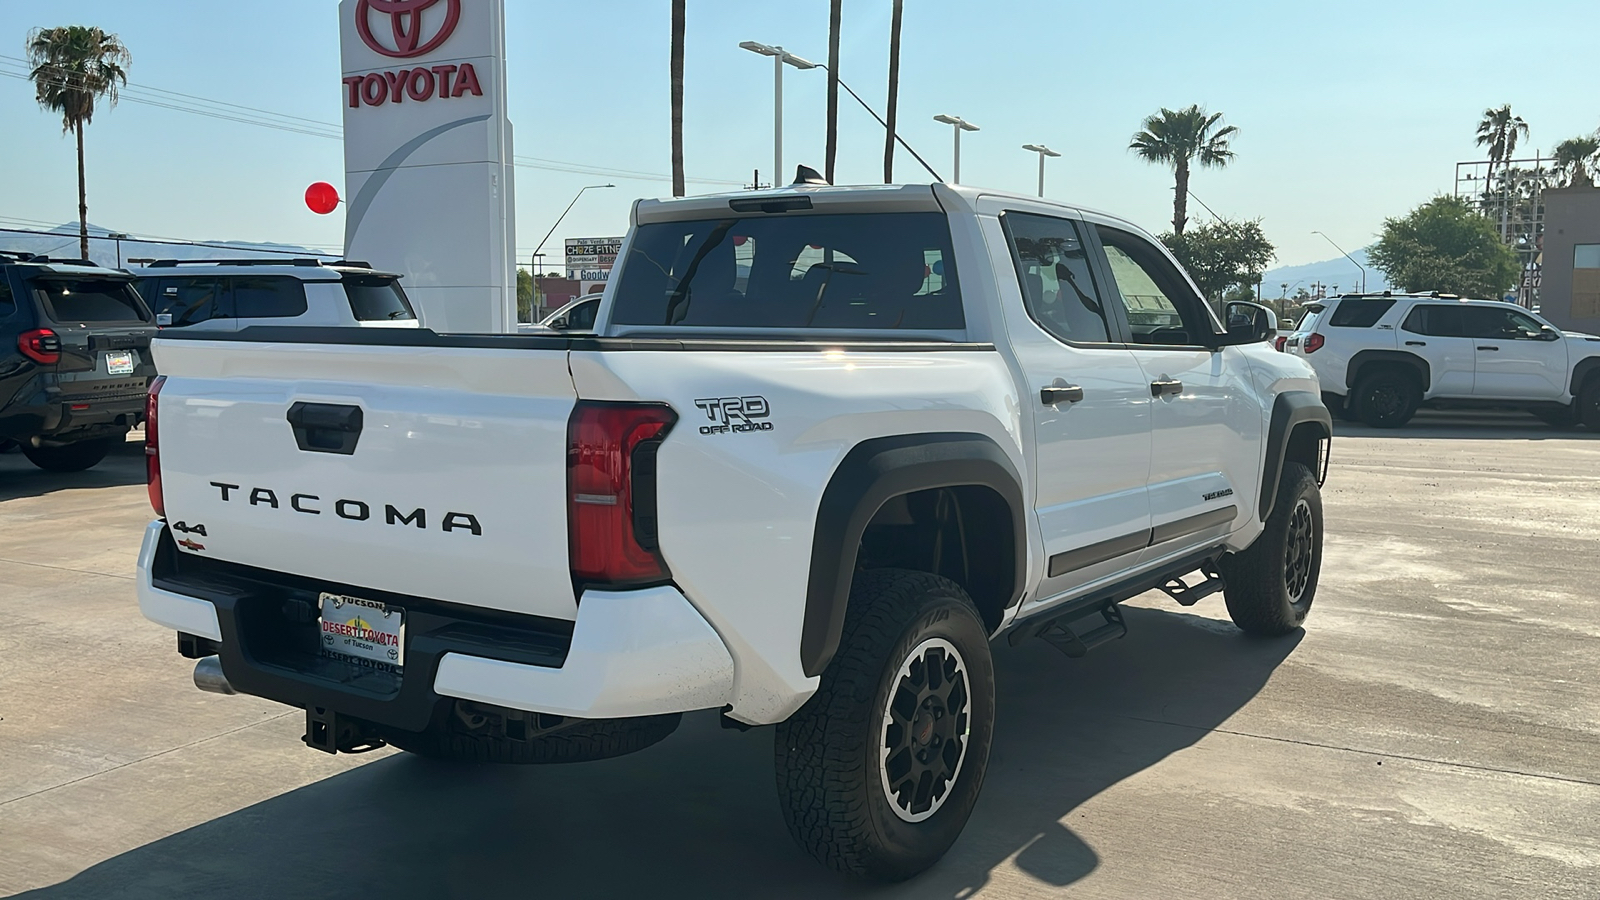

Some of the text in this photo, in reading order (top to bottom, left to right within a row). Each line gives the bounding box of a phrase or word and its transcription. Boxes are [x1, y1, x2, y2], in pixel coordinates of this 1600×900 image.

[343, 63, 483, 108] TOYOTA
[597, 245, 620, 254] FITNE
[581, 269, 609, 280] Goodw
[694, 395, 770, 425] TRD
[699, 422, 774, 435] OFF ROAD
[210, 481, 482, 536] TACOMA
[342, 597, 384, 610] TUCSON
[322, 620, 399, 647] DESERT TOYOTA
[352, 639, 374, 651] Tucson
